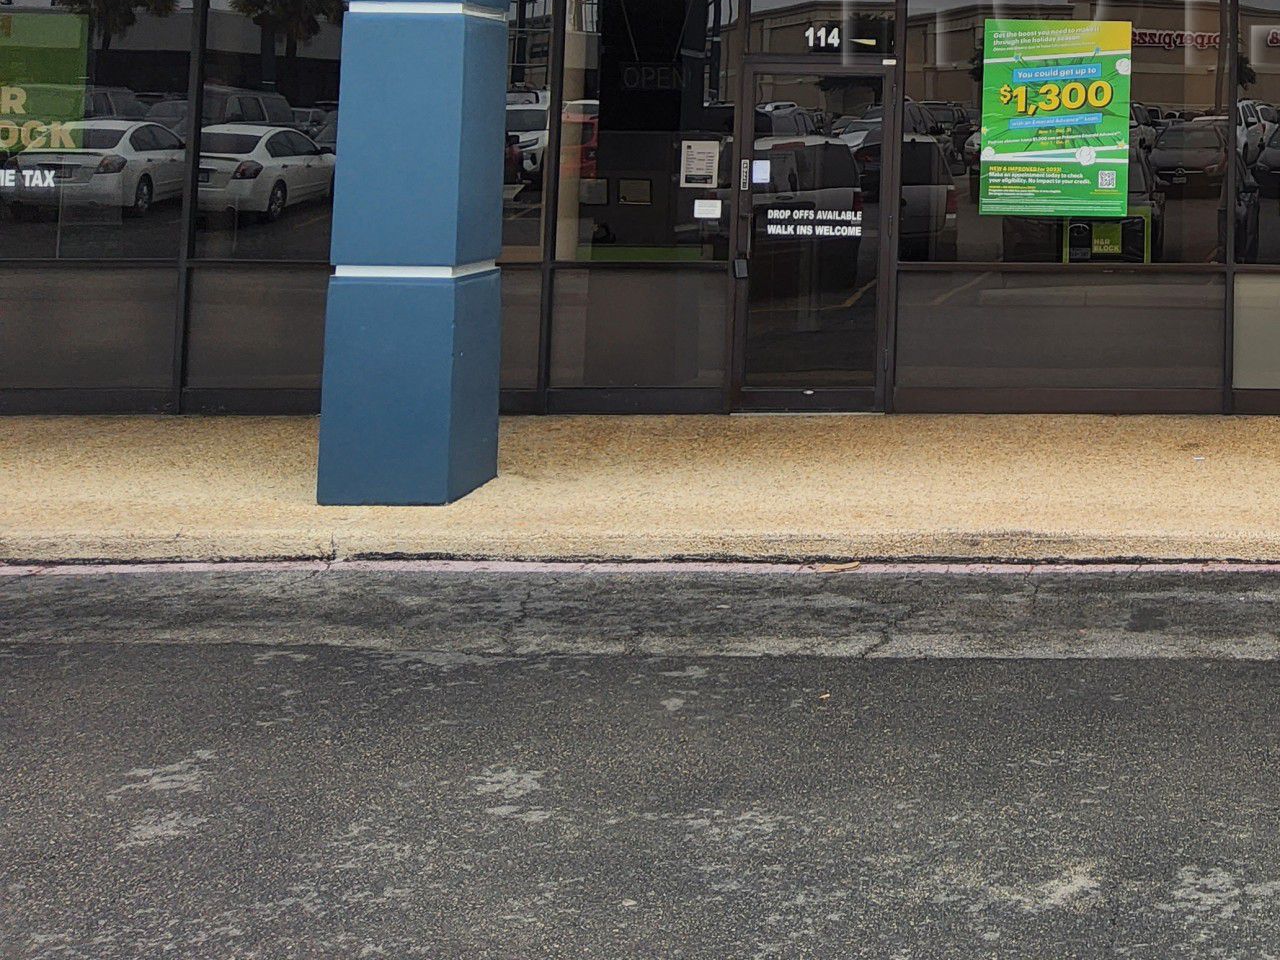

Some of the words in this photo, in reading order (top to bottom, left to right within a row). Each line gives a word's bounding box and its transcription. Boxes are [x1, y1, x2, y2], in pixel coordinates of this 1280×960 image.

[804, 26, 840, 48] 114
[1038, 29, 1049, 37] you
[994, 38, 1020, 46] through
[1018, 70, 1033, 79] You
[1035, 68, 1059, 78] could
[1059, 68, 1074, 78] get
[1076, 69, 1087, 77] up
[1000, 80, 1114, 117] $1,300
[22, 169, 56, 188] TAX
[768, 209, 791, 220] DROP
[793, 209, 815, 220] OFFS
[816, 210, 862, 221] AVAILABLE
[767, 225, 794, 235] WALK
[797, 225, 813, 236] INS
[815, 225, 862, 237] WELCOME
